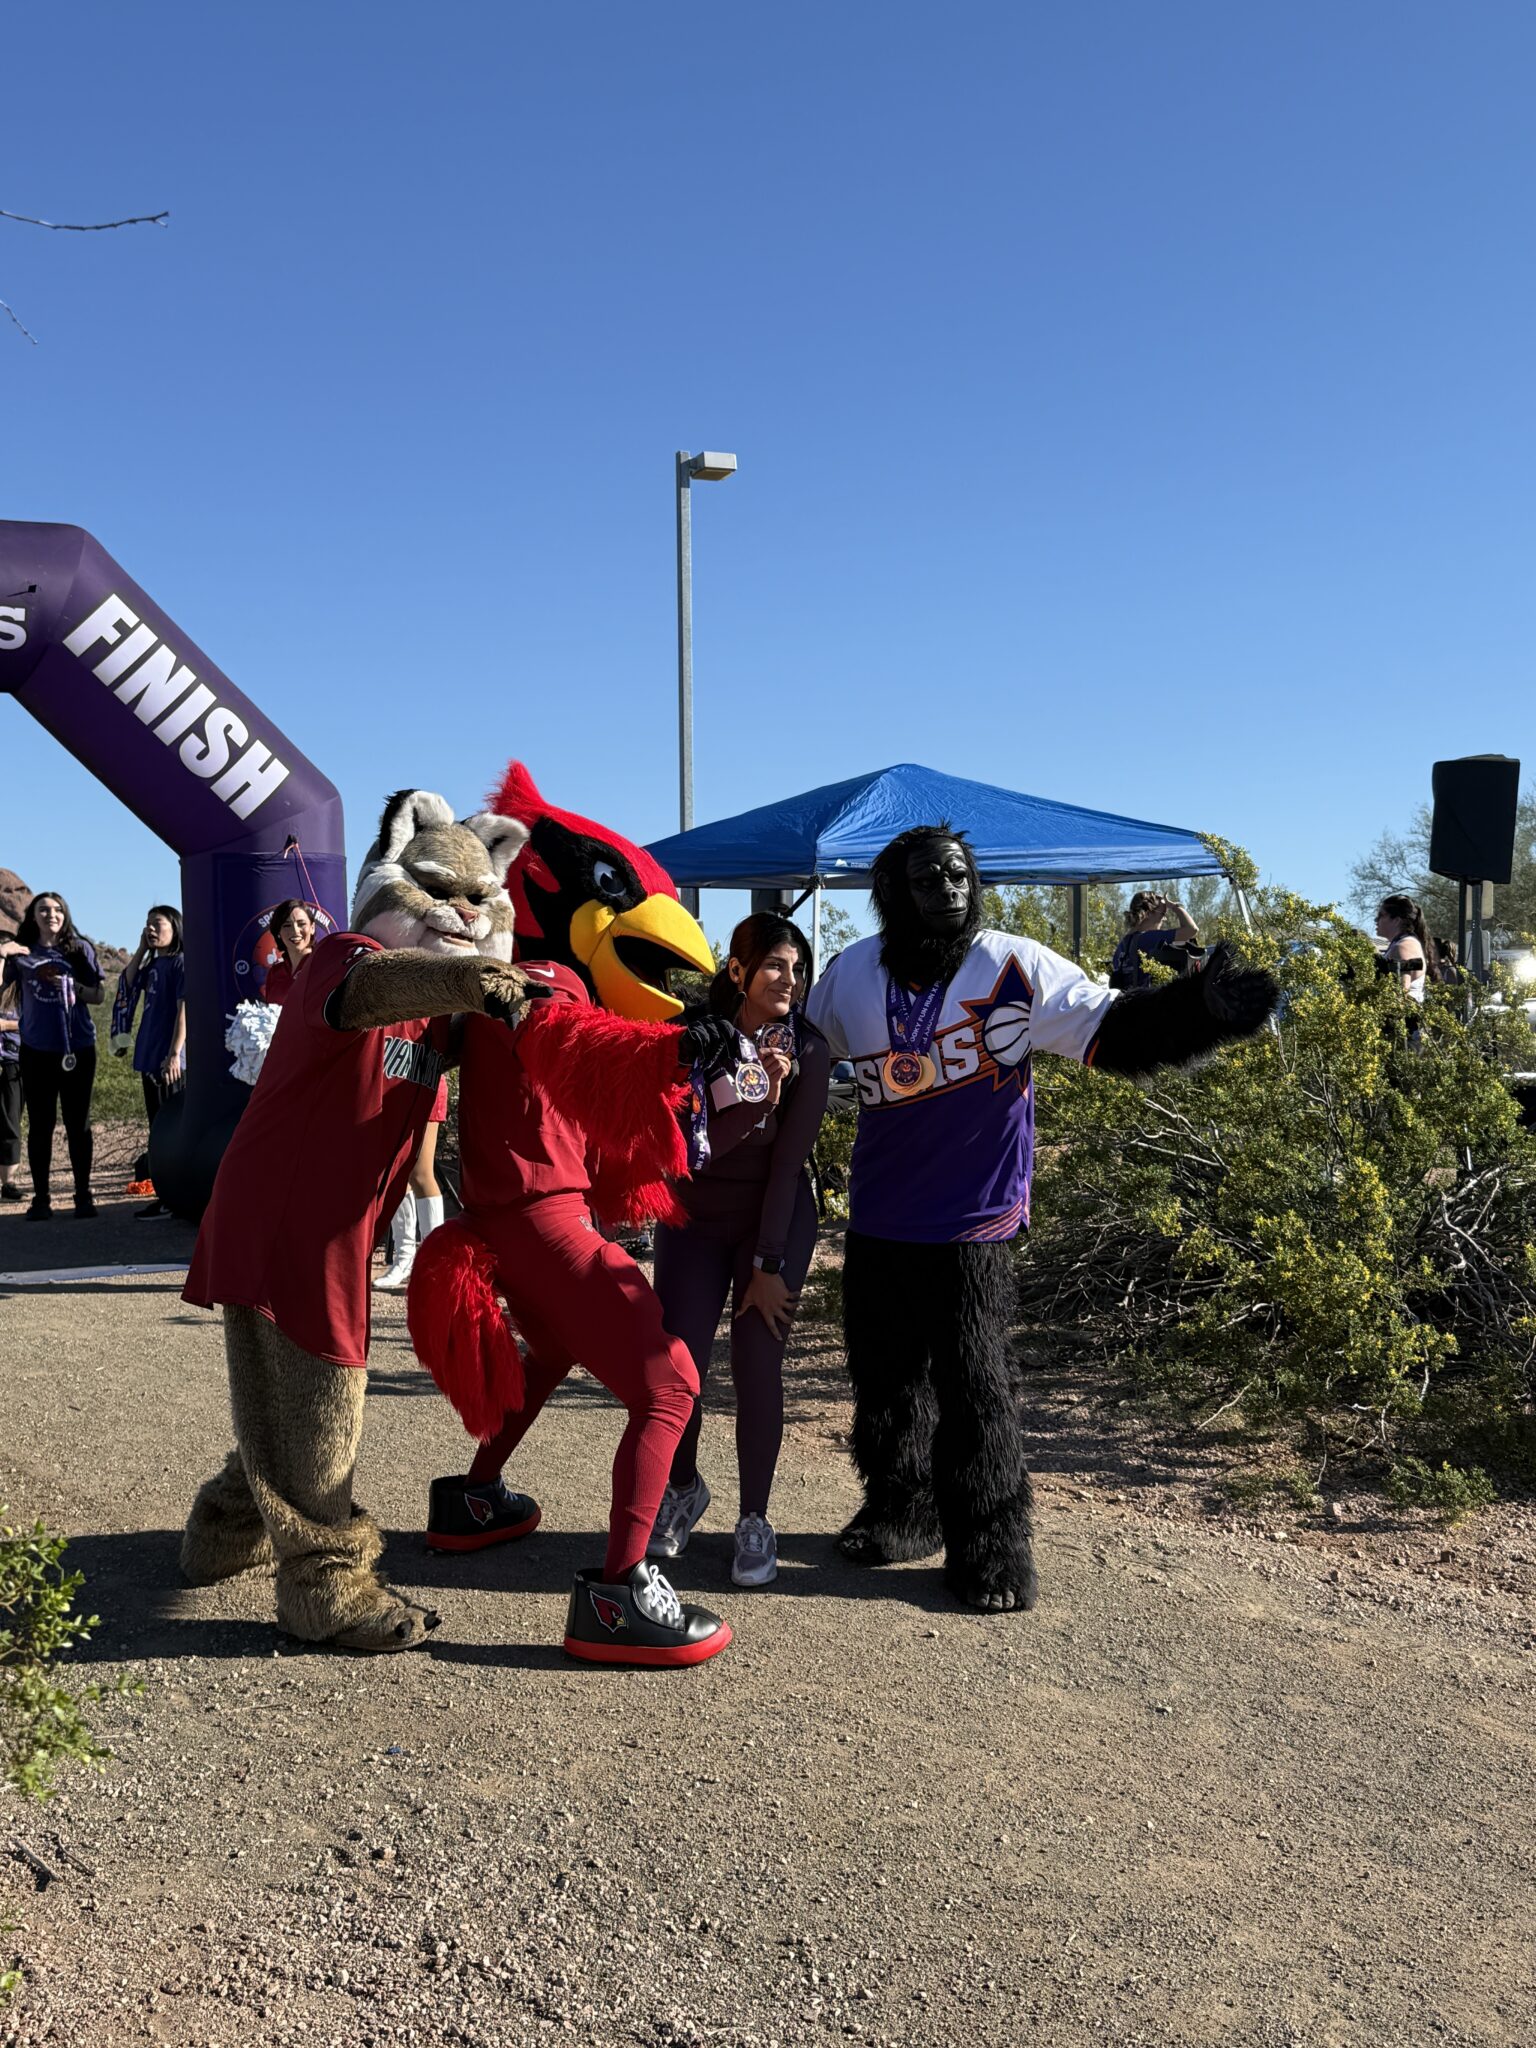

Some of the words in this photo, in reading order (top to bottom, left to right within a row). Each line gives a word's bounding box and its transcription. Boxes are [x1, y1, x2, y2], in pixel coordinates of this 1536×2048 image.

[62, 593, 290, 821] FINISH
[315, 911, 331, 927] RUN
[918, 1007, 928, 1022] FUN
